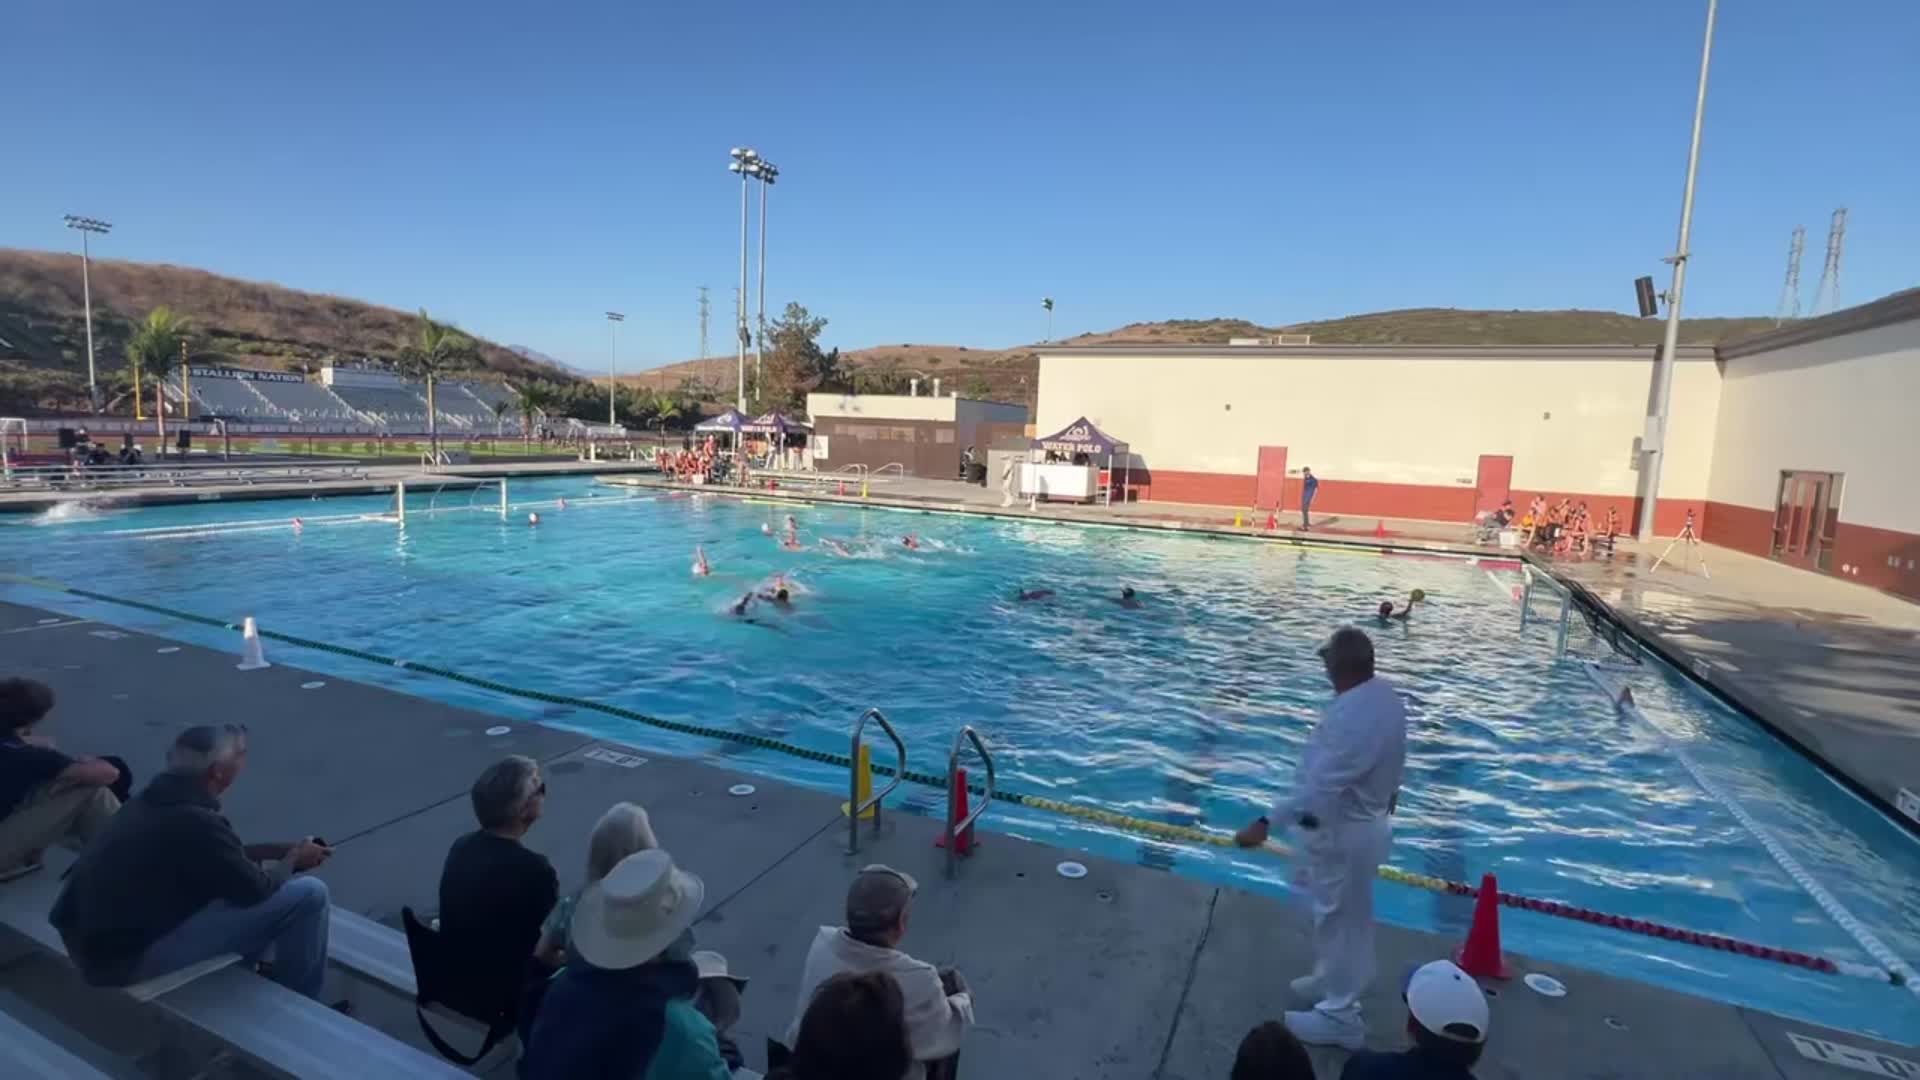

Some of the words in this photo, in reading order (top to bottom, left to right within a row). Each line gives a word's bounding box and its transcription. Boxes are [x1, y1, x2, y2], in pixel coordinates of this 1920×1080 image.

[192, 368, 255, 380] STALLION
[258, 373, 303, 383] NATION
[1041, 441, 1075, 452] WATER
[1077, 444, 1102, 454] POLO
